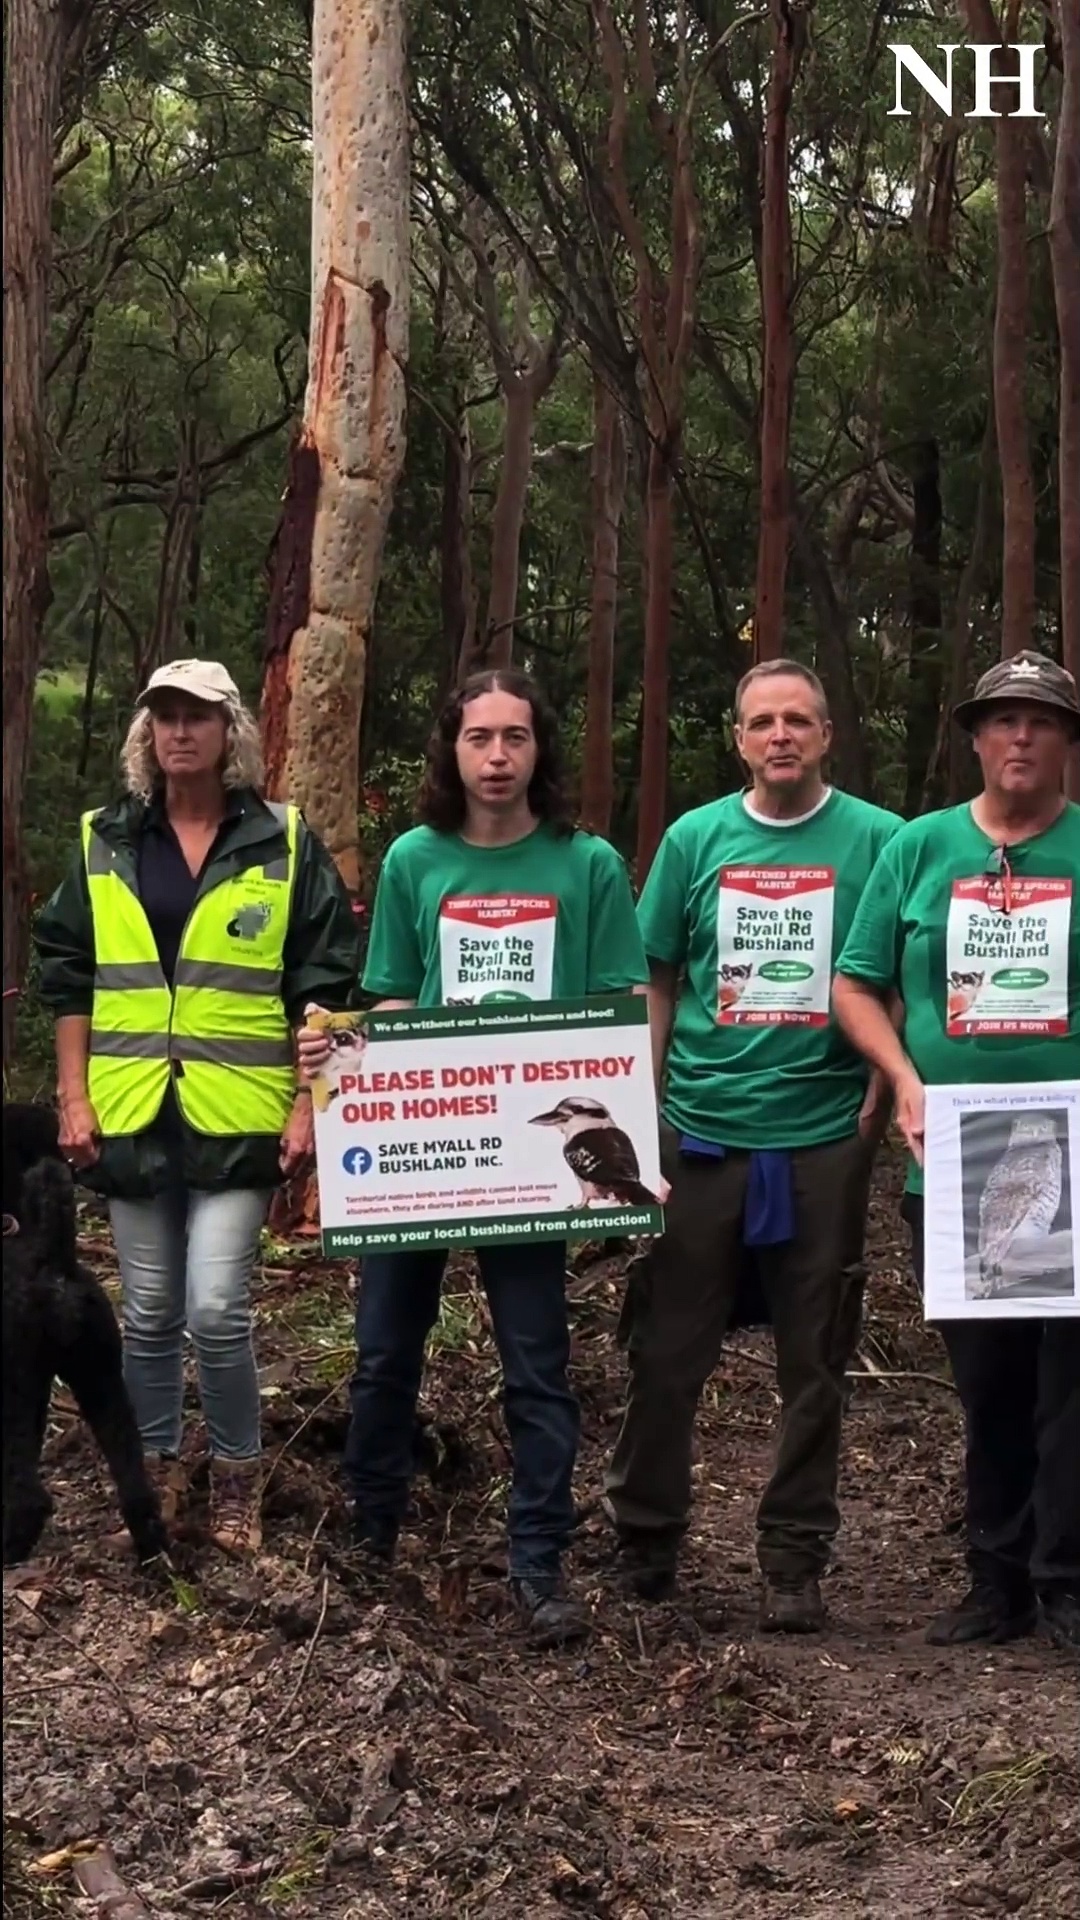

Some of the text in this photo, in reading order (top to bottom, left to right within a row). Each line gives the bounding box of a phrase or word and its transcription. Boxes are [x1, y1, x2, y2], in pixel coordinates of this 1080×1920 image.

[727, 870, 829, 880] THREATENED SPECIES
[756, 880, 797, 890] HABITAT
[736, 907, 813, 920] Save the
[737, 922, 812, 936] Myall Rd
[968, 914, 1048, 930] Save the
[968, 928, 1046, 944] Myall Rd
[459, 936, 534, 952] Save the
[734, 937, 814, 951] Bushland
[964, 944, 1050, 958] Bushland
[460, 952, 532, 968] Myall Rd
[458, 968, 535, 983] Bushland
[374, 1008, 614, 1032] We die without our bushland homes and food!
[746, 1012, 767, 1022] JOIN
[770, 1013, 782, 1022] US
[977, 1022, 1000, 1030] JOIN
[340, 1056, 636, 1094] PLEASE DON'T DESTROY
[984, 1096, 1008, 1104] what
[342, 1094, 498, 1124] OUR HOMES!
[378, 1142, 420, 1158] SAVE
[424, 1138, 476, 1154] MYALL
[480, 1136, 503, 1150] RD
[379, 1154, 503, 1174] BUSHLAND INC.
[438, 1188, 455, 1198] and
[412, 1202, 426, 1212] die
[456, 1200, 474, 1208] AND
[332, 1213, 652, 1248] Help save your local bushland from destruction!
